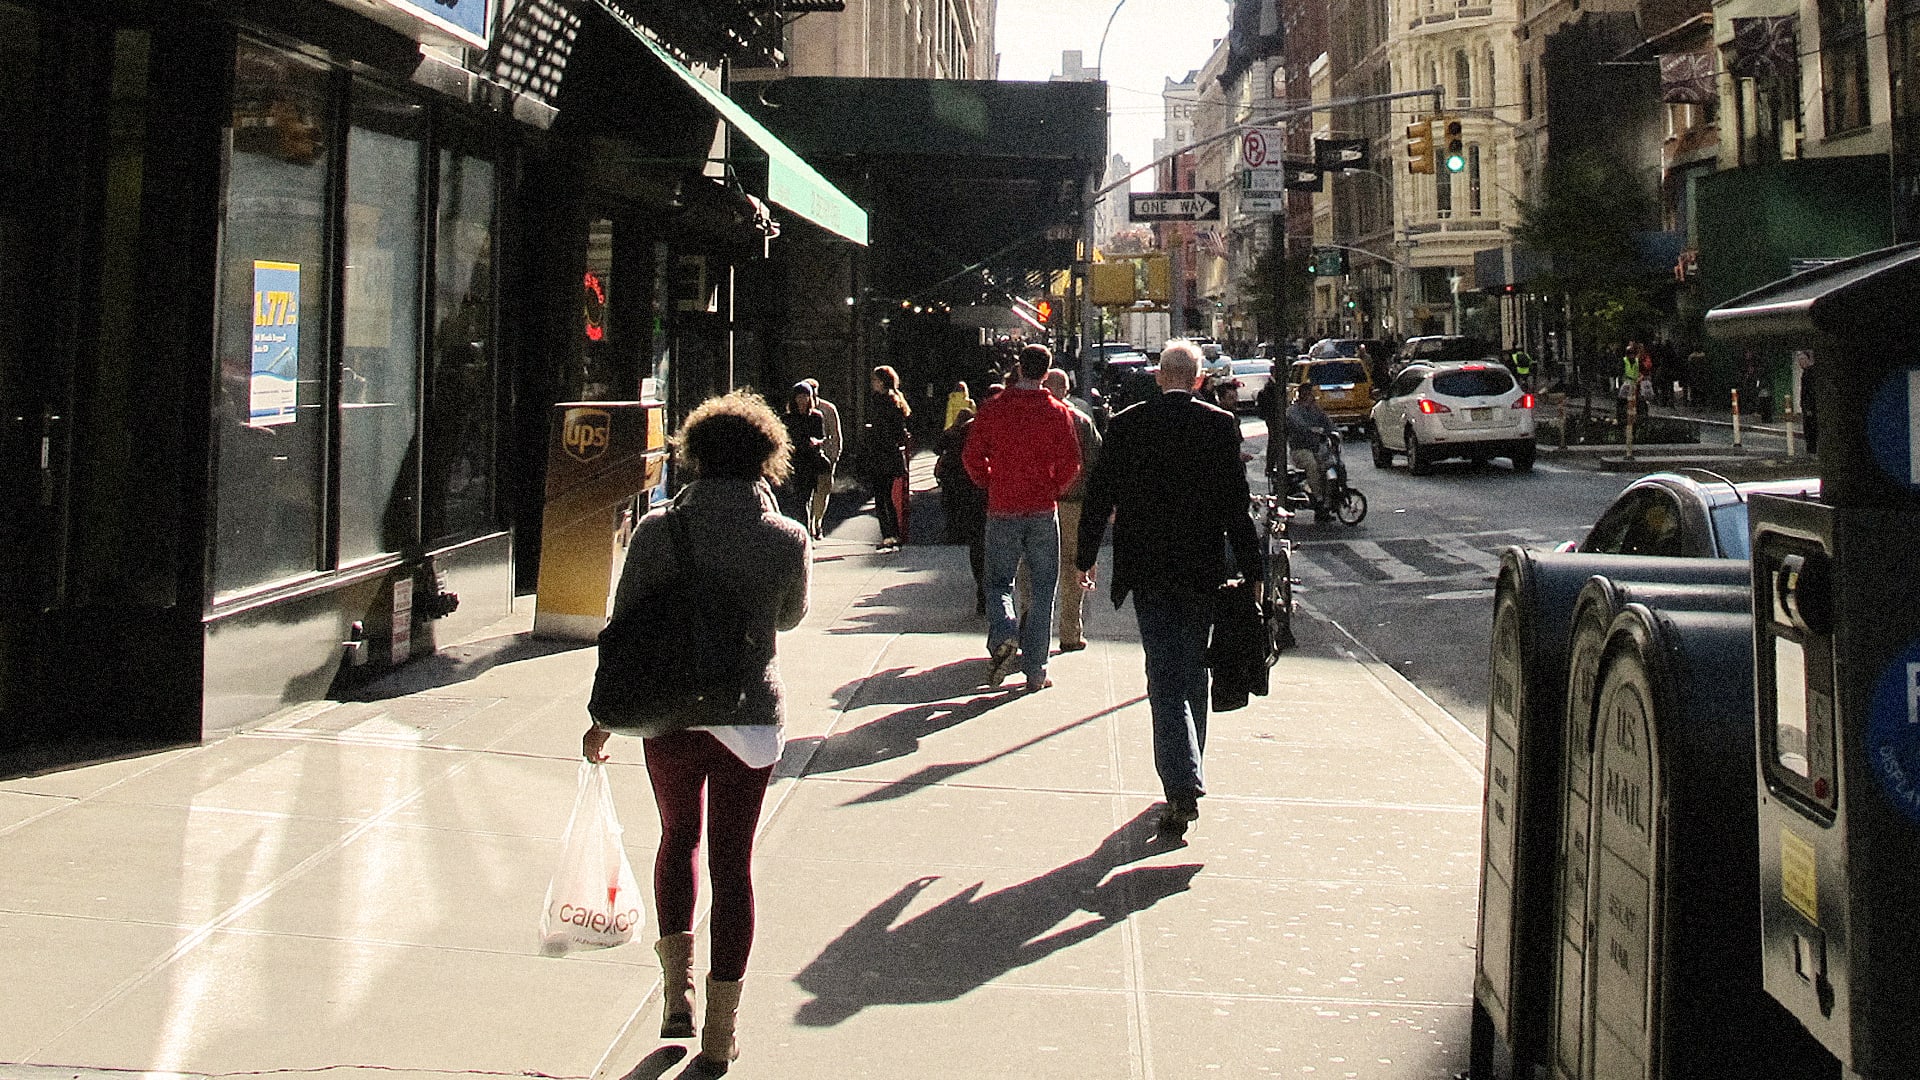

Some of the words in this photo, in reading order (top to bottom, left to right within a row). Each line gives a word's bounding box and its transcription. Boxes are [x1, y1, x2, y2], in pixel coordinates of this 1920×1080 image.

[1141, 201, 1168, 213] ONE
[1180, 200, 1207, 213] WAY
[566, 424, 607, 455] ups
[1606, 766, 1645, 833] MAIL
